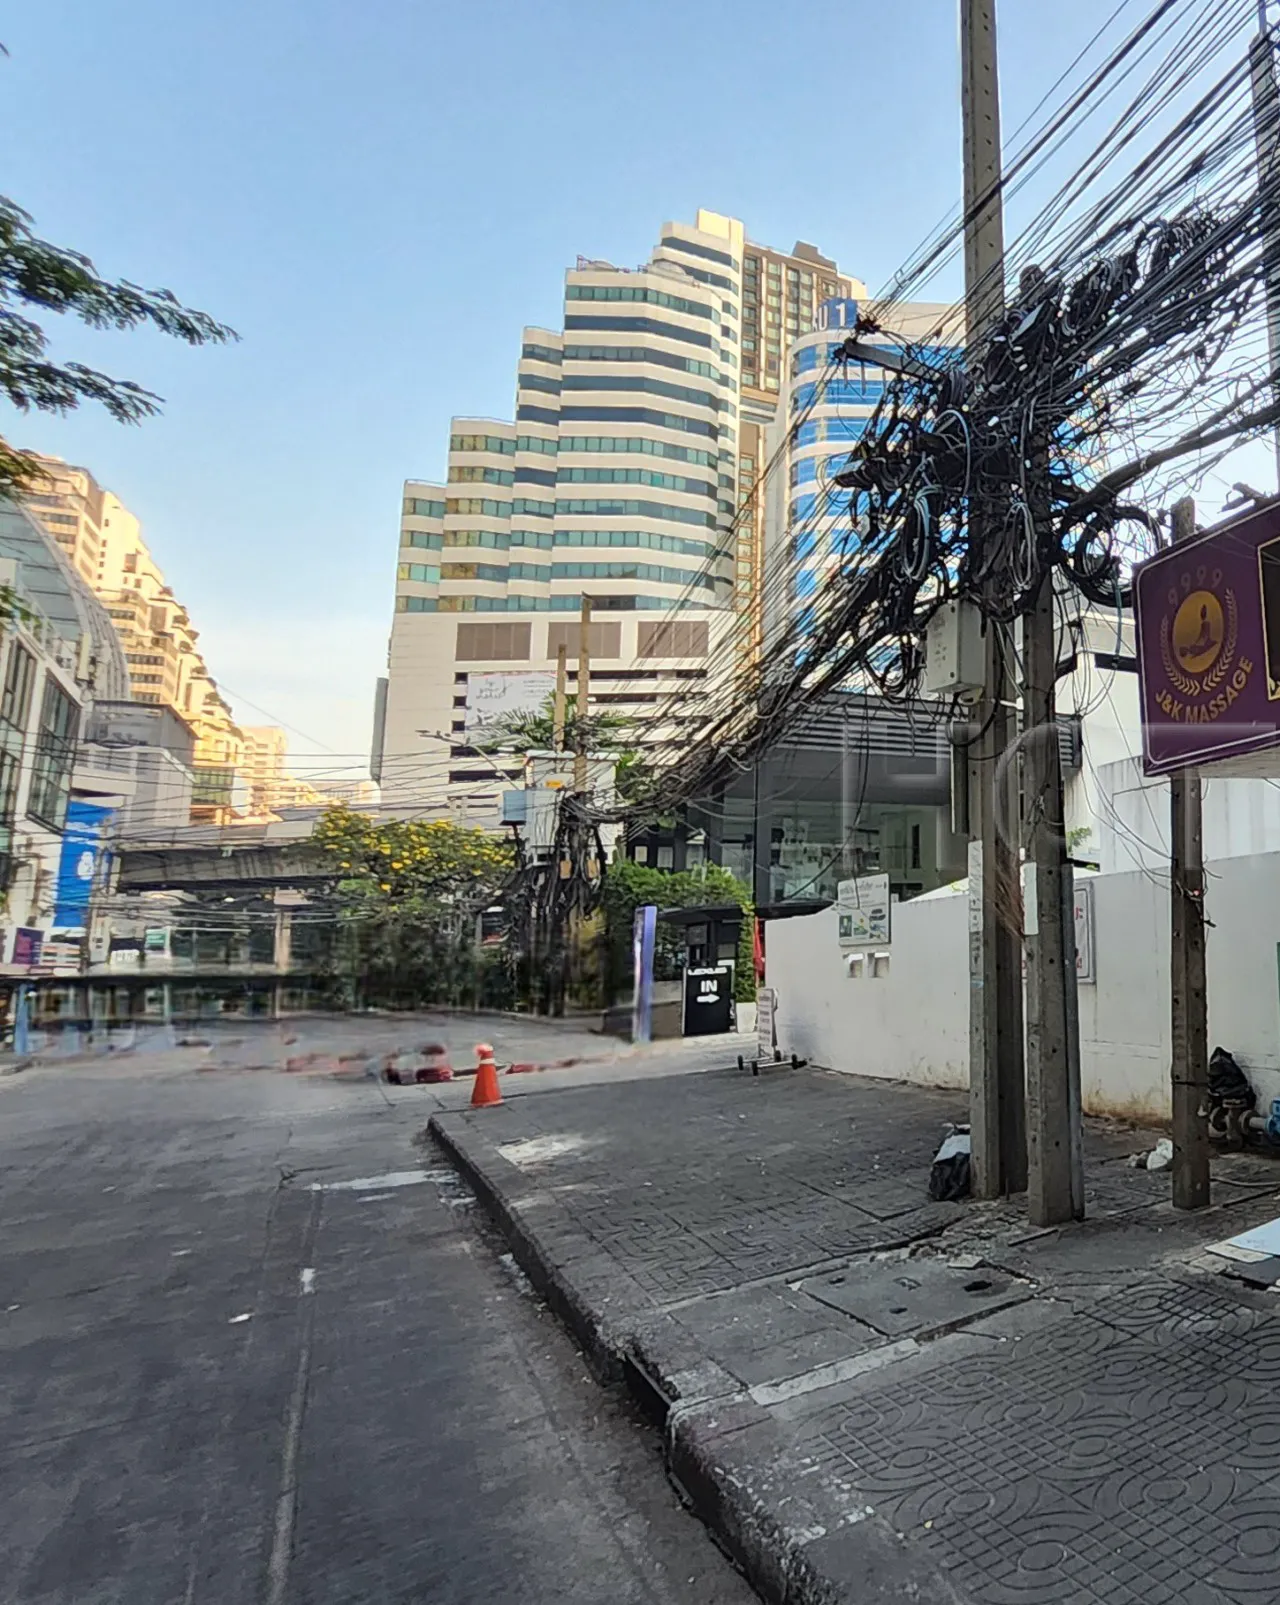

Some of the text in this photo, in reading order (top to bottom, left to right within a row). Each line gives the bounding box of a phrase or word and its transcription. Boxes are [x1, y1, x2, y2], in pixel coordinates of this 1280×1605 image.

[1167, 565, 1224, 606] 9999
[1155, 656, 1253, 724] J&K MASSAGE
[700, 979, 718, 993] IN
